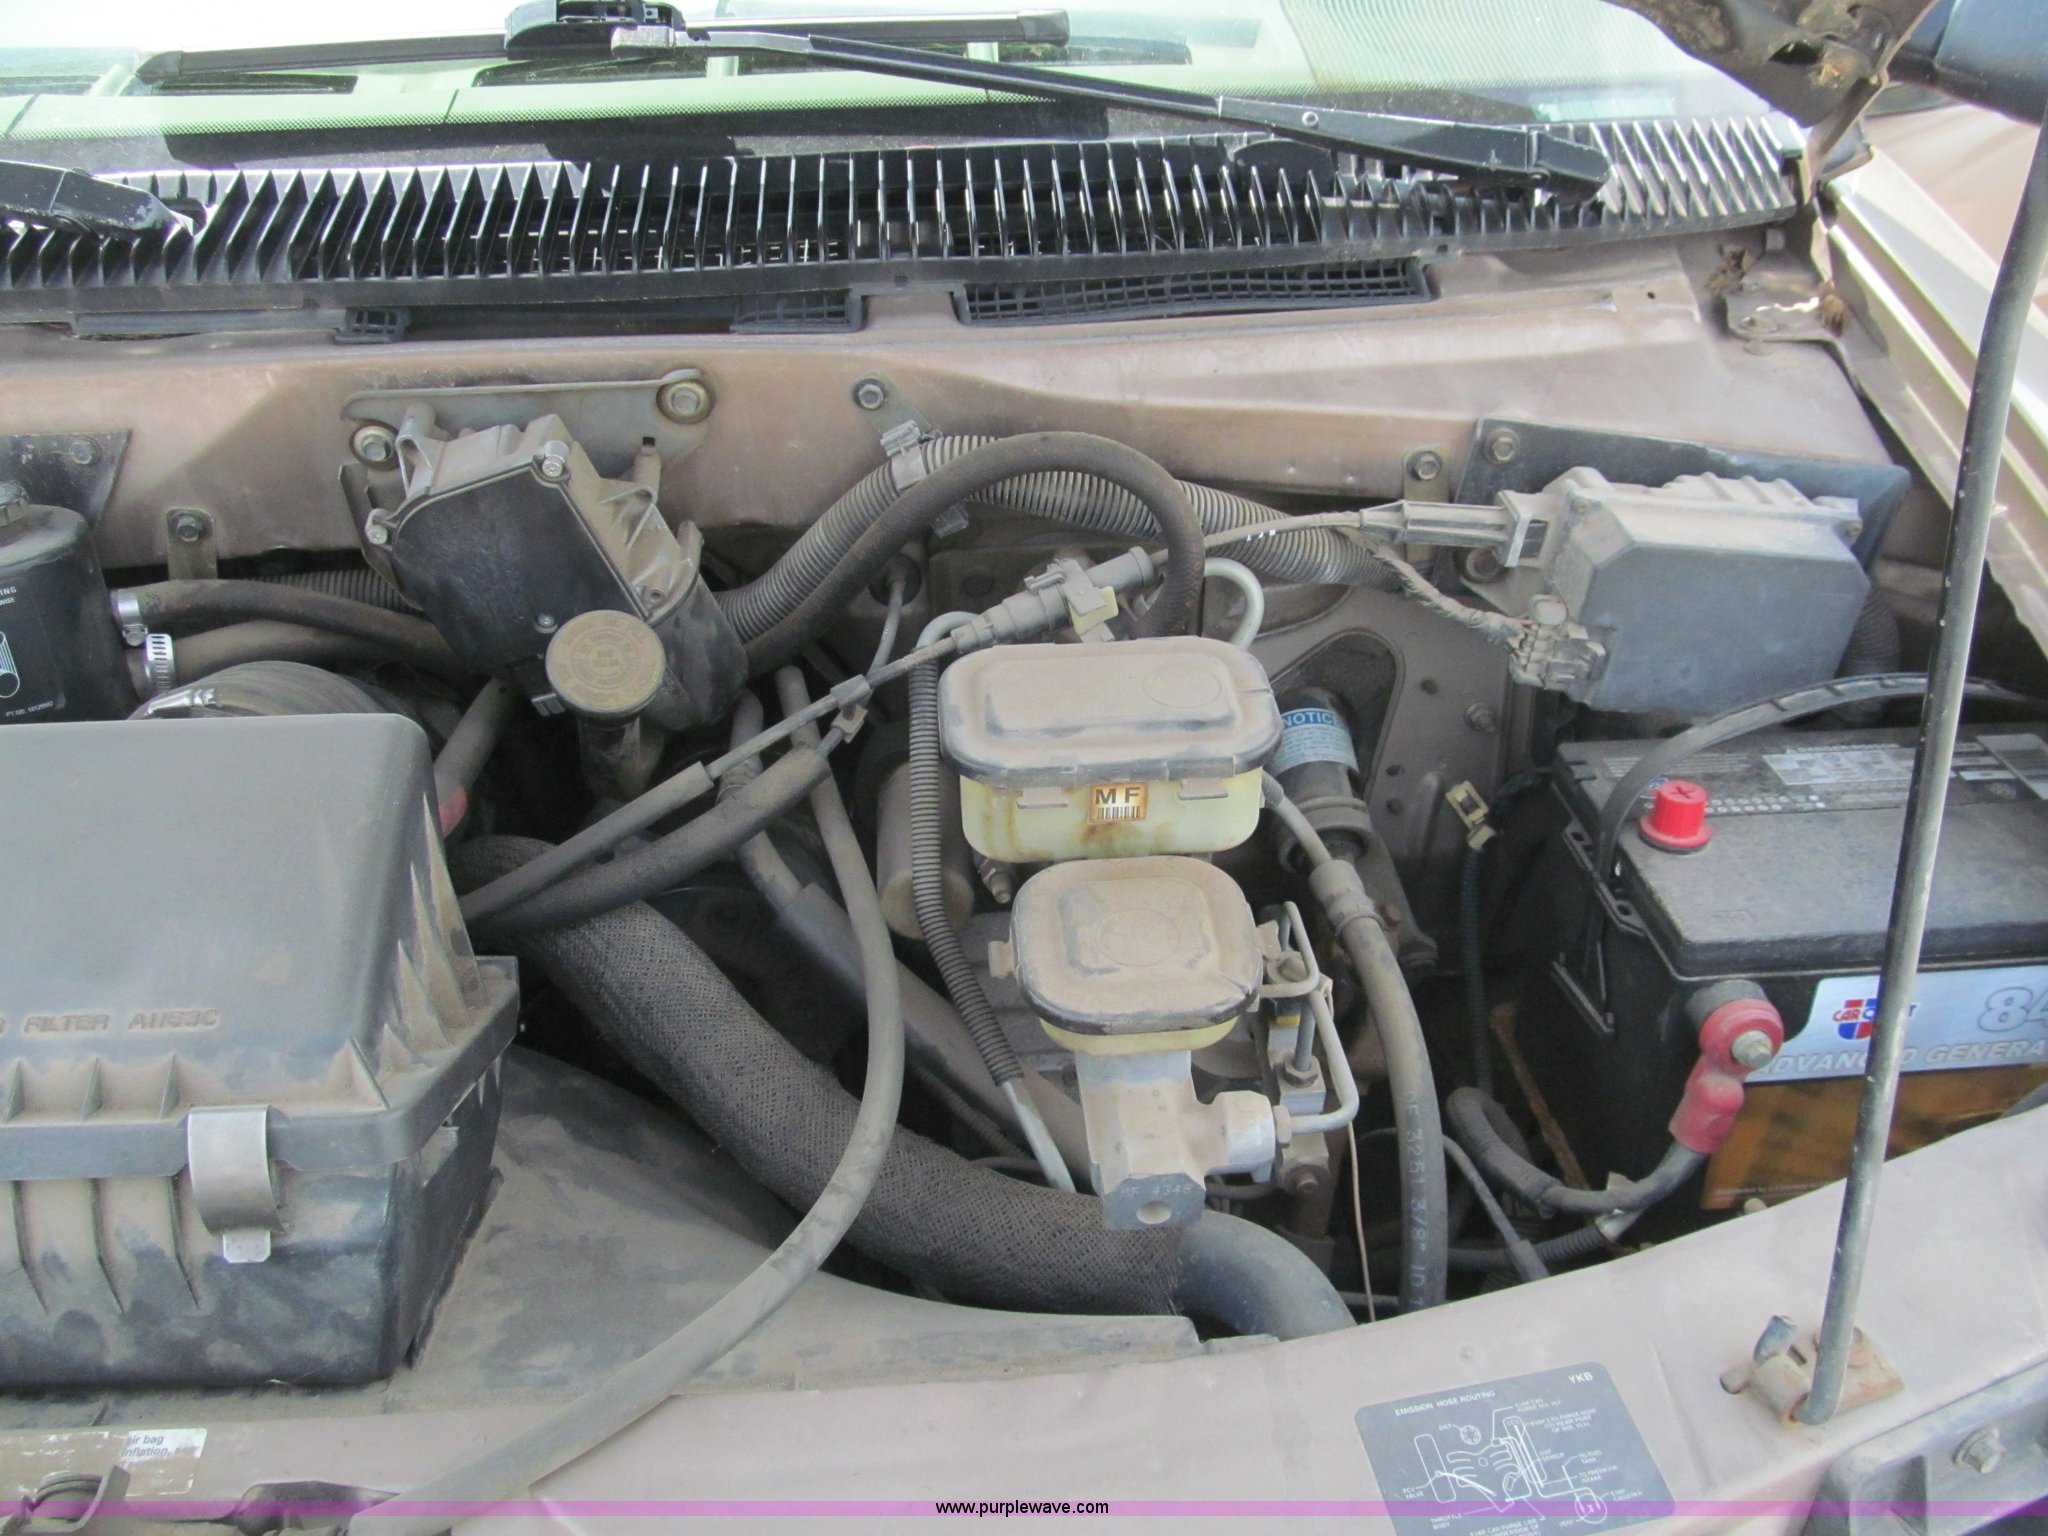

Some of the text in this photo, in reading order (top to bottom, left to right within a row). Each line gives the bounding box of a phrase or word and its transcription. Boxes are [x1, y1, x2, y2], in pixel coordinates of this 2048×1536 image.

[24, 1014, 111, 1034] FILTER
[1567, 1371, 1594, 1385] YKB
[1394, 1390, 1496, 1417] EMISSION HOSE ROUTING
[143, 1435, 165, 1446] bag
